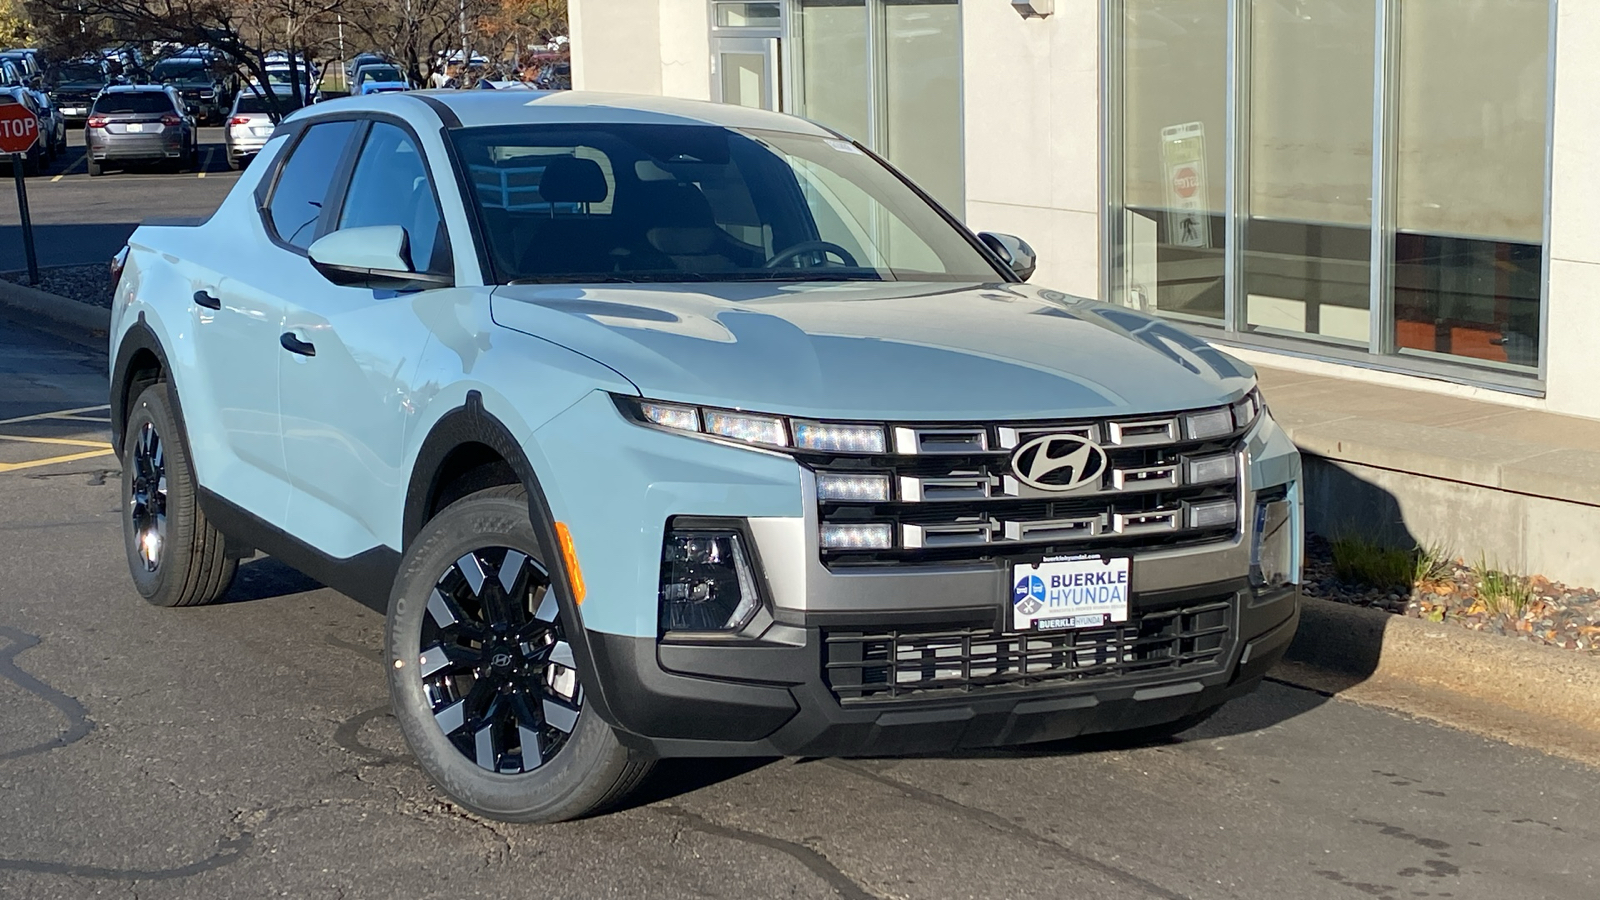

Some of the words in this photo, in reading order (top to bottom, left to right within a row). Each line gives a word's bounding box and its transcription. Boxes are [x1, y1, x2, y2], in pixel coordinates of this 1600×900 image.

[0, 117, 35, 138] TOP
[1043, 554, 1101, 562] buerklehyundai.com
[1051, 571, 1126, 588] BUERKLE
[1049, 586, 1126, 607] HYUNDAI
[1039, 619, 1075, 629] BUERKLE
